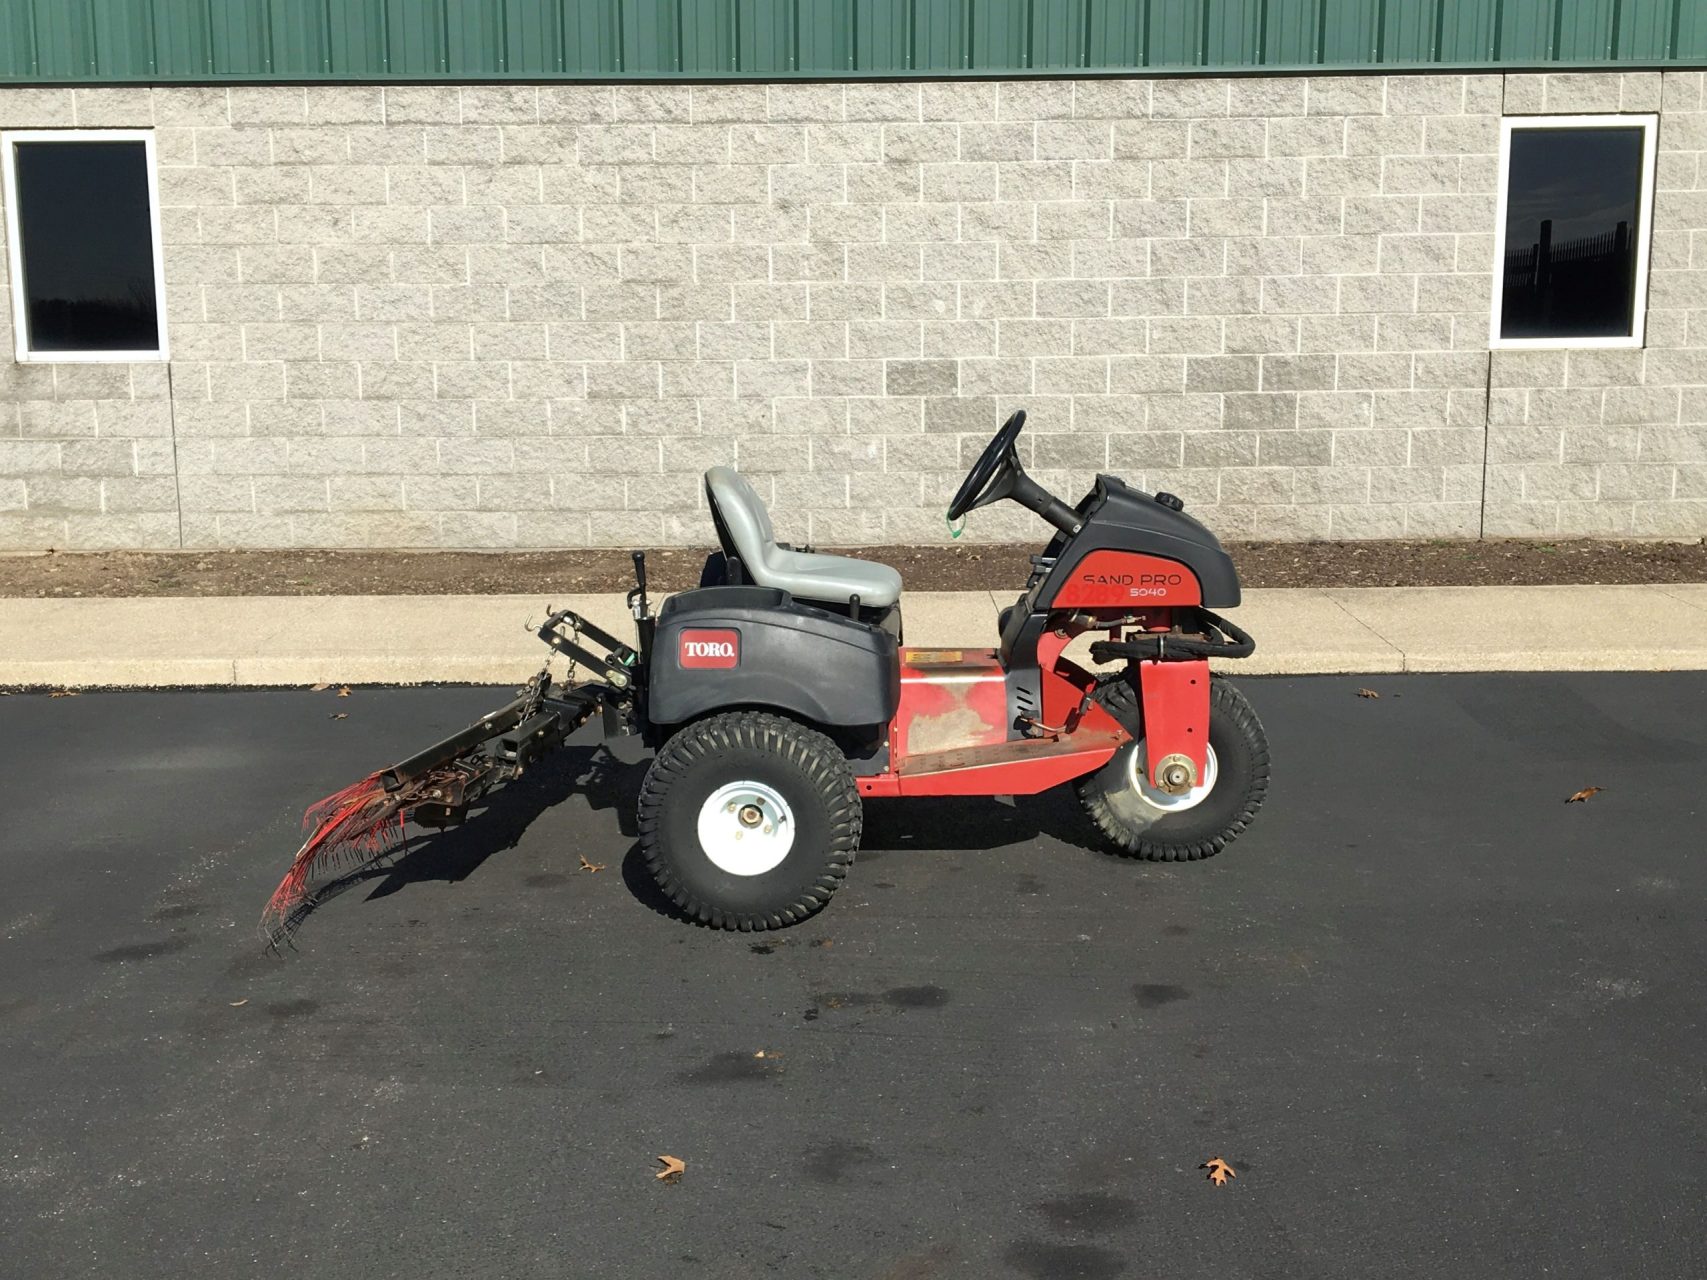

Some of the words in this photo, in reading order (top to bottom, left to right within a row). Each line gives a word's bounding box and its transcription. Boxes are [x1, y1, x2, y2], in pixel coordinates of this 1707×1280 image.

[1083, 574, 1134, 586] SAND
[1140, 574, 1182, 586] PRO
[1130, 588, 1167, 597] 5040
